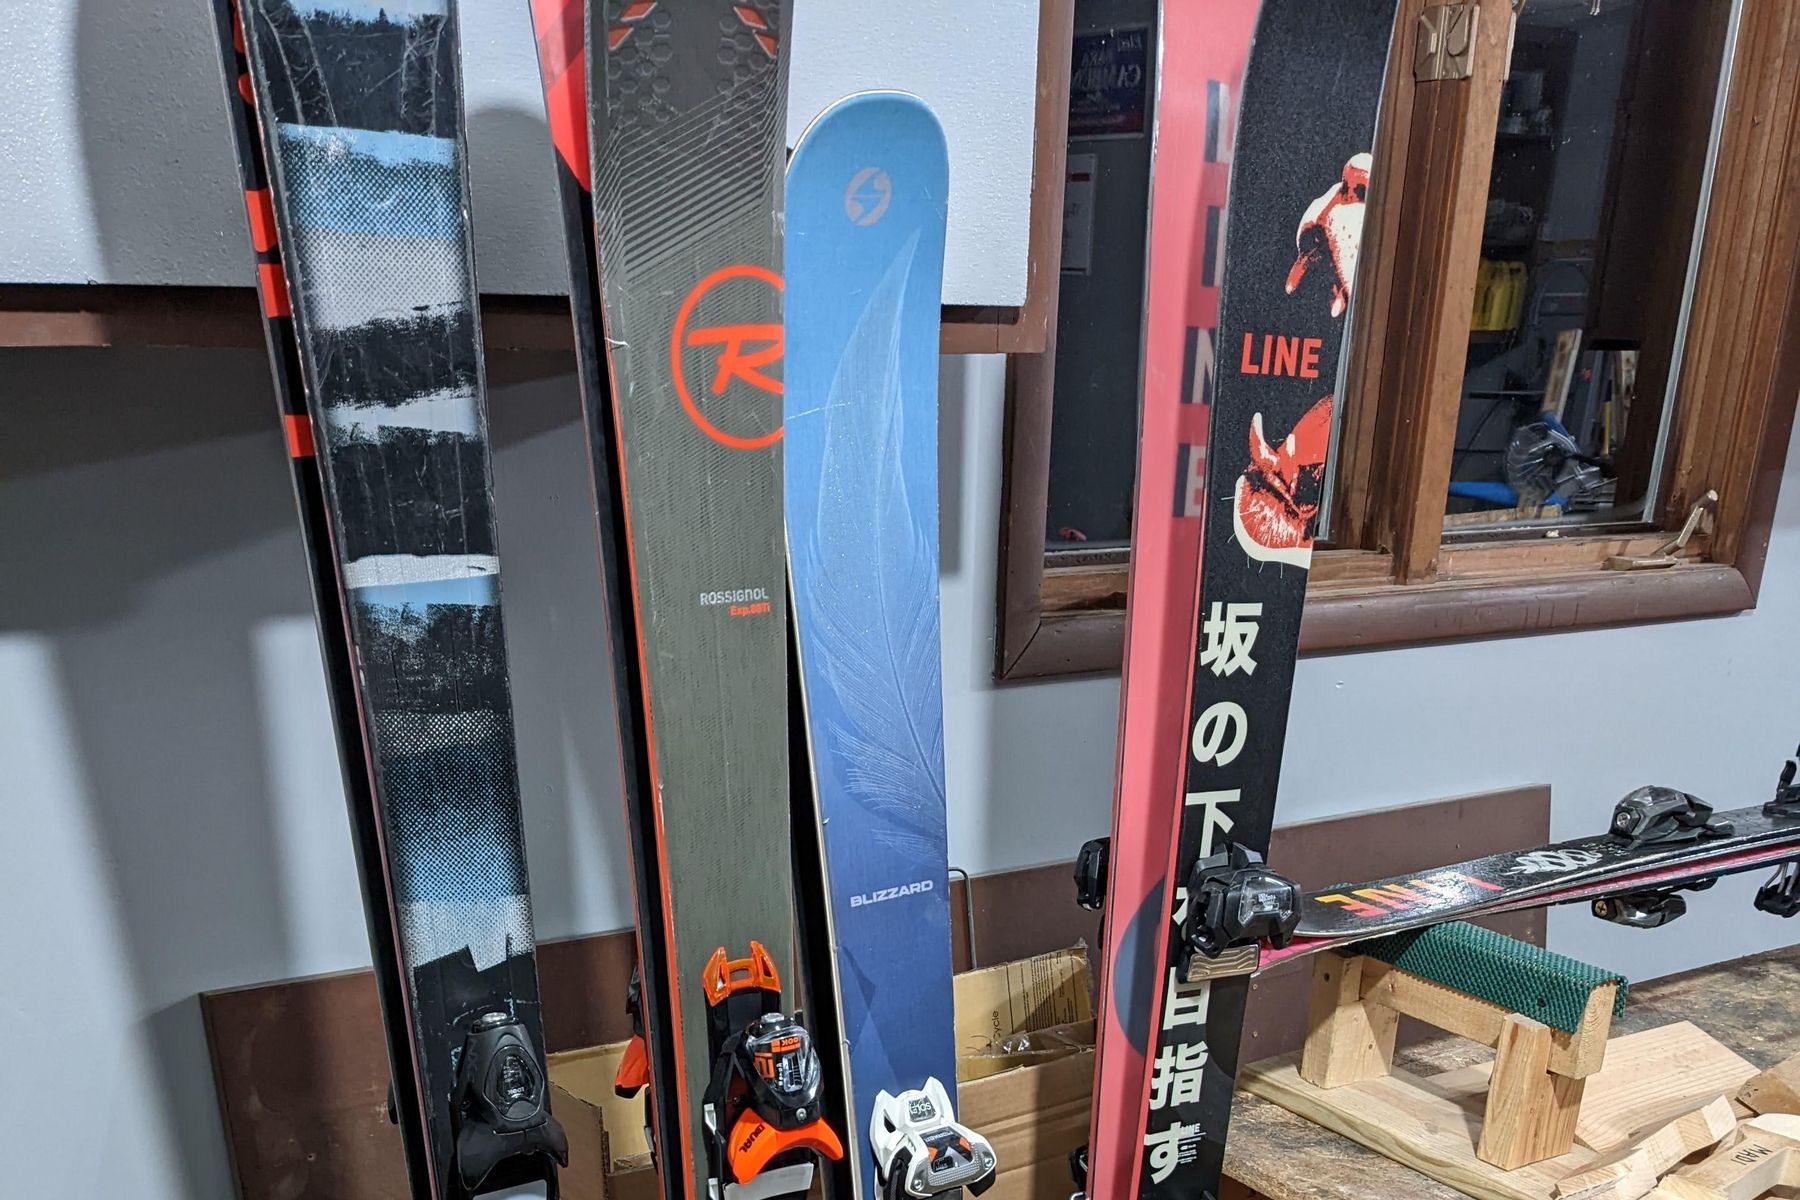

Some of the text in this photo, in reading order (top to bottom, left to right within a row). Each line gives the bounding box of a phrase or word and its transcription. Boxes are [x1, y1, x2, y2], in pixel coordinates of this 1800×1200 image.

[1240, 332, 1322, 379] LINE
[699, 588, 769, 605] ROSSIGNOL
[850, 880, 934, 908] BLIZZARD
[1143, 601, 1263, 1185] 坂の下目指す
[739, 1124, 766, 1153] DUAL
